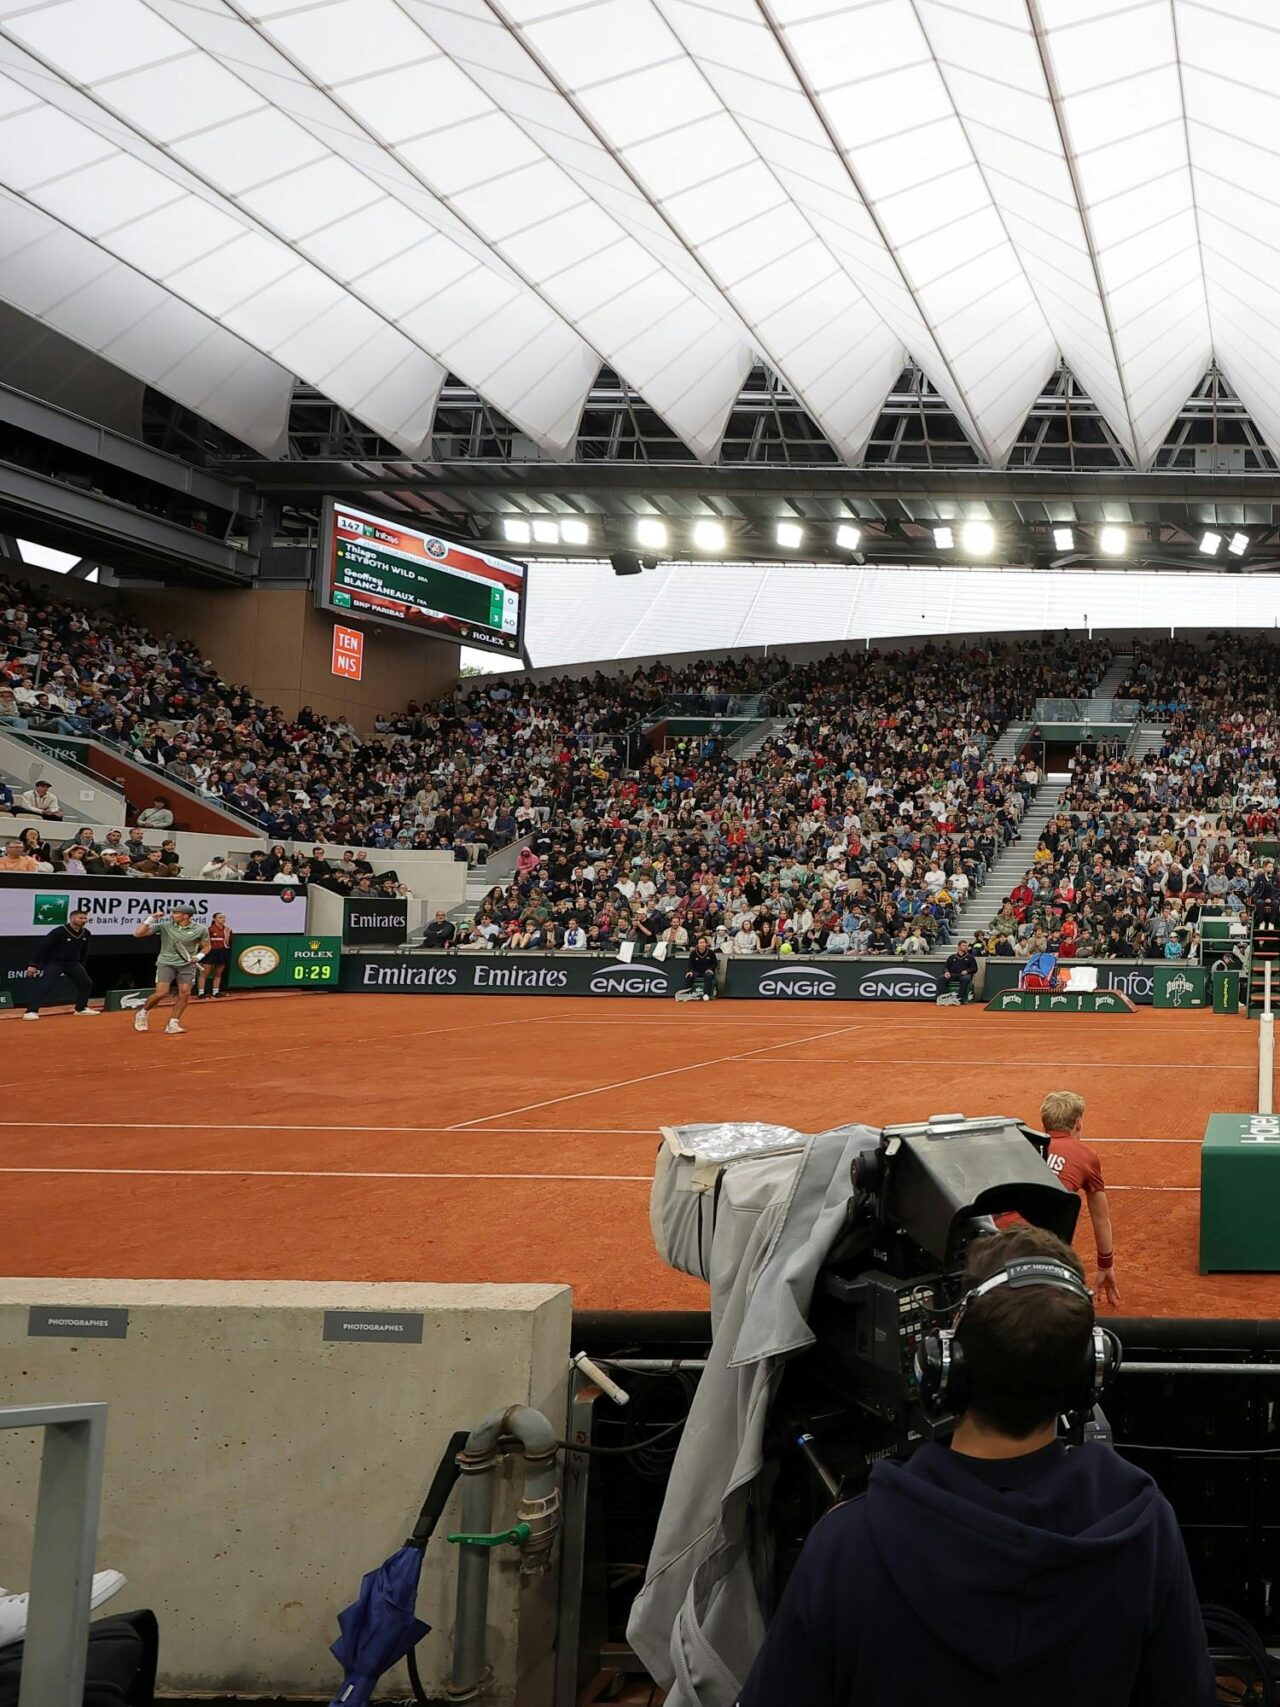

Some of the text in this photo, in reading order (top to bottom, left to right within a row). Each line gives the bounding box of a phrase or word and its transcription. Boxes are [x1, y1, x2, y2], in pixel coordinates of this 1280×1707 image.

[341, 519, 361, 532] 147
[345, 543, 377, 560] Thiago
[345, 551, 390, 572] SEYBOTH
[390, 565, 416, 579] WILD
[344, 568, 383, 586] Geoffrey
[344, 576, 415, 602] BLANCANEAUX
[494, 593, 500, 601] 3
[353, 599, 405, 619] BNP PARIBAS
[493, 614, 499, 623] 3
[504, 618, 516, 627] 40
[339, 632, 358, 651] TEN
[472, 631, 504, 646] ROLEX
[337, 654, 357, 672] NIS
[33, 742, 77, 760] irates
[78, 897, 122, 914] BNP
[96, 917, 121, 925] bank
[120, 917, 134, 925] for
[350, 913, 406, 928] Emirates
[294, 965, 331, 980] 0:29
[363, 964, 457, 985] Emirates
[473, 966, 568, 987] Emirates
[1108, 971, 1154, 996] Infos
[47, 1318, 109, 1327] PHOTOGRAPHES
[343, 1323, 404, 1332] PHOTOGRAPHES
